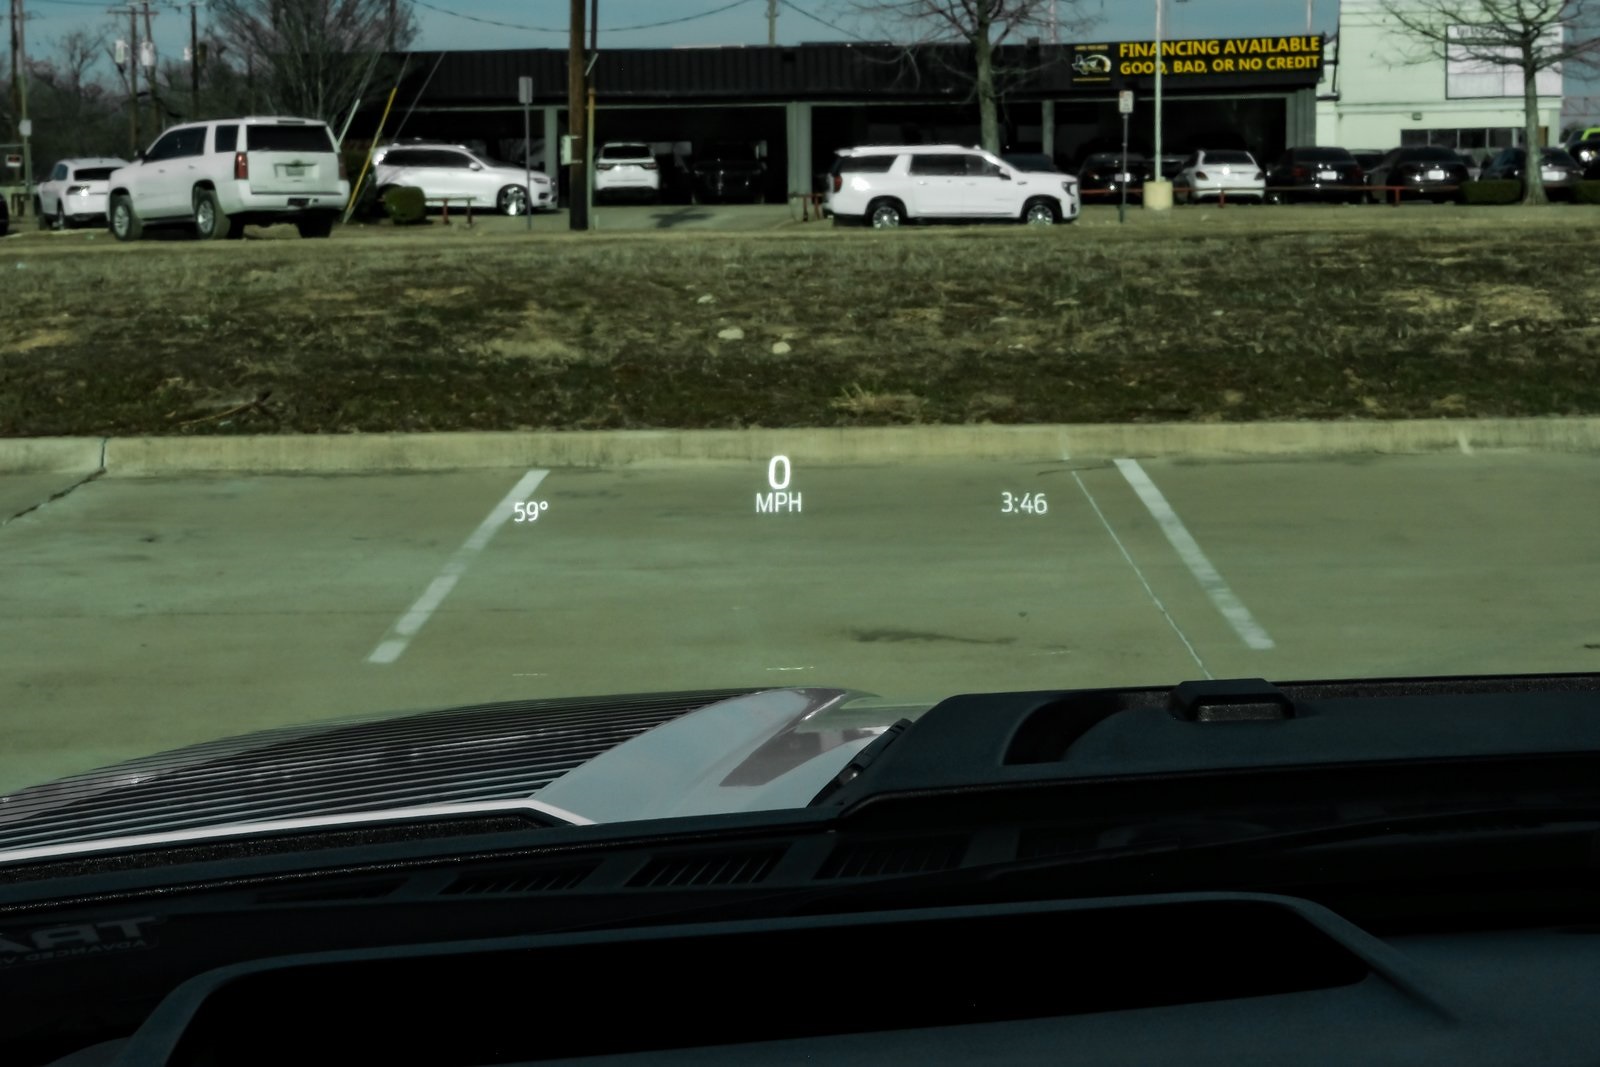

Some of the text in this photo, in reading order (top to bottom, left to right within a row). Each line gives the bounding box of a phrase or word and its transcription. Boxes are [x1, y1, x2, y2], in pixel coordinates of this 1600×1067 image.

[1120, 36, 1319, 57] FINANCING AVAILABLE
[1120, 55, 1318, 75] GOOD, BAD, OR NO CREDIT
[768, 455, 791, 490] 0
[514, 500, 549, 522] 59°
[756, 491, 802, 513] MPH
[1001, 491, 1048, 514] 3:46
